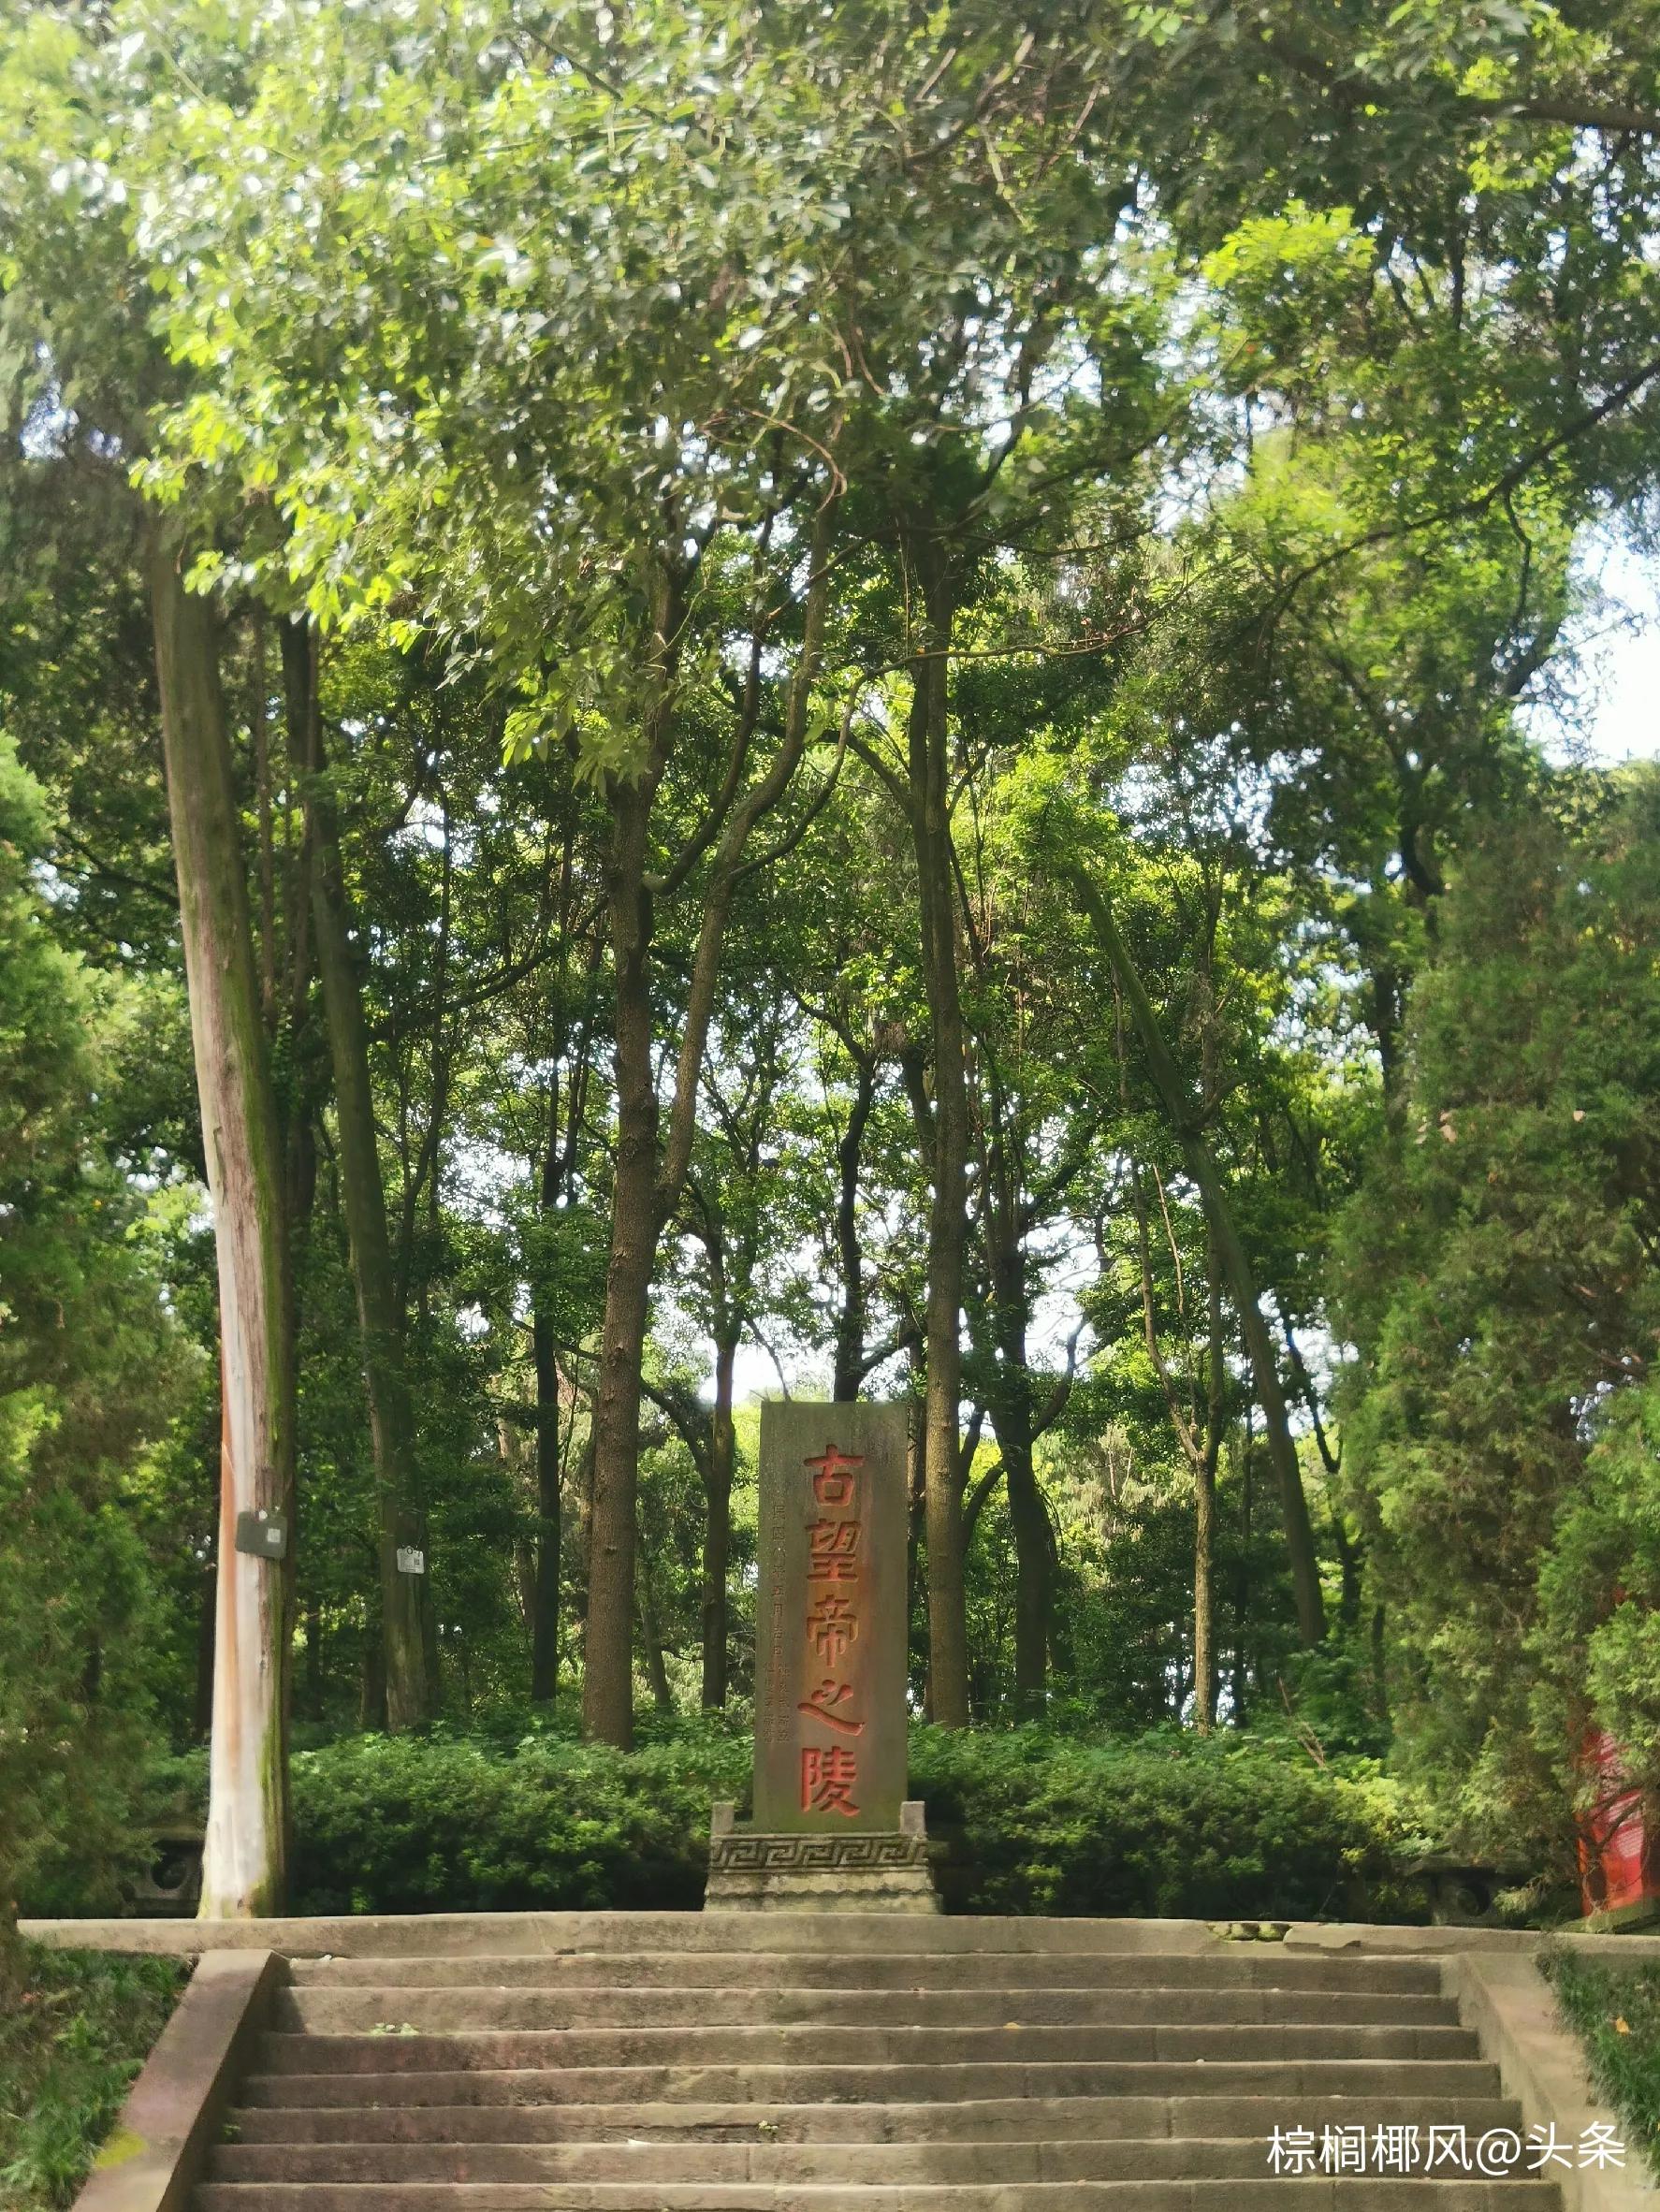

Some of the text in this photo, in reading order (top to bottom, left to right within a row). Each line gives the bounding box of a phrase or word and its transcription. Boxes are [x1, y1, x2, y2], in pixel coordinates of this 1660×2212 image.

[797, 1443, 866, 1817] 古望帝之陵
